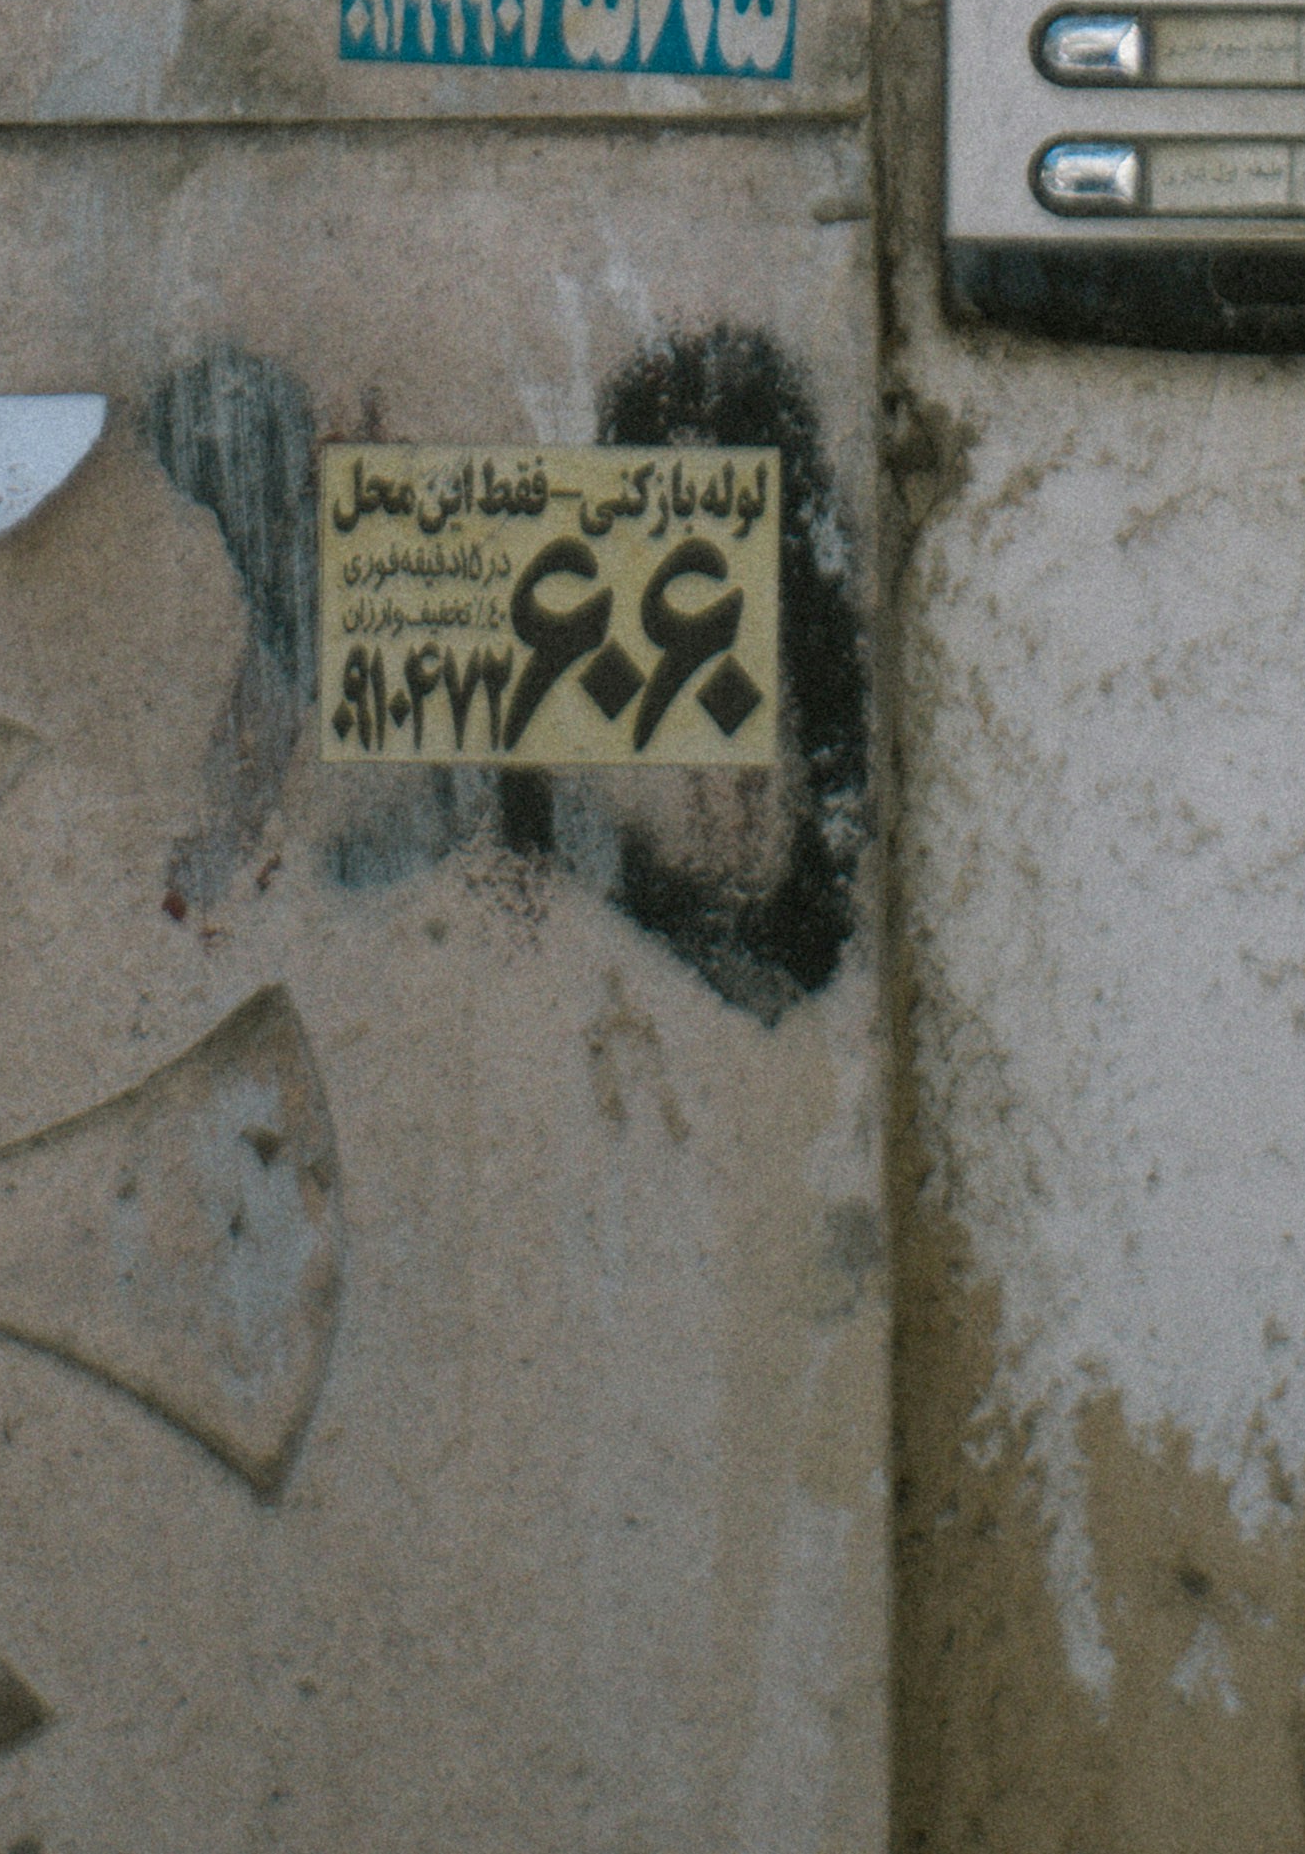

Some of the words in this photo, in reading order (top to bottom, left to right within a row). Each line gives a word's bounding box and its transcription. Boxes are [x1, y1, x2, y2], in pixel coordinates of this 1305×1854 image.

[333, 457, 417, 534] محل
[417, 458, 474, 534] این
[478, 455, 548, 516] فقط
[579, 459, 696, 539] بازکنی
[699, 458, 768, 540] لوله
